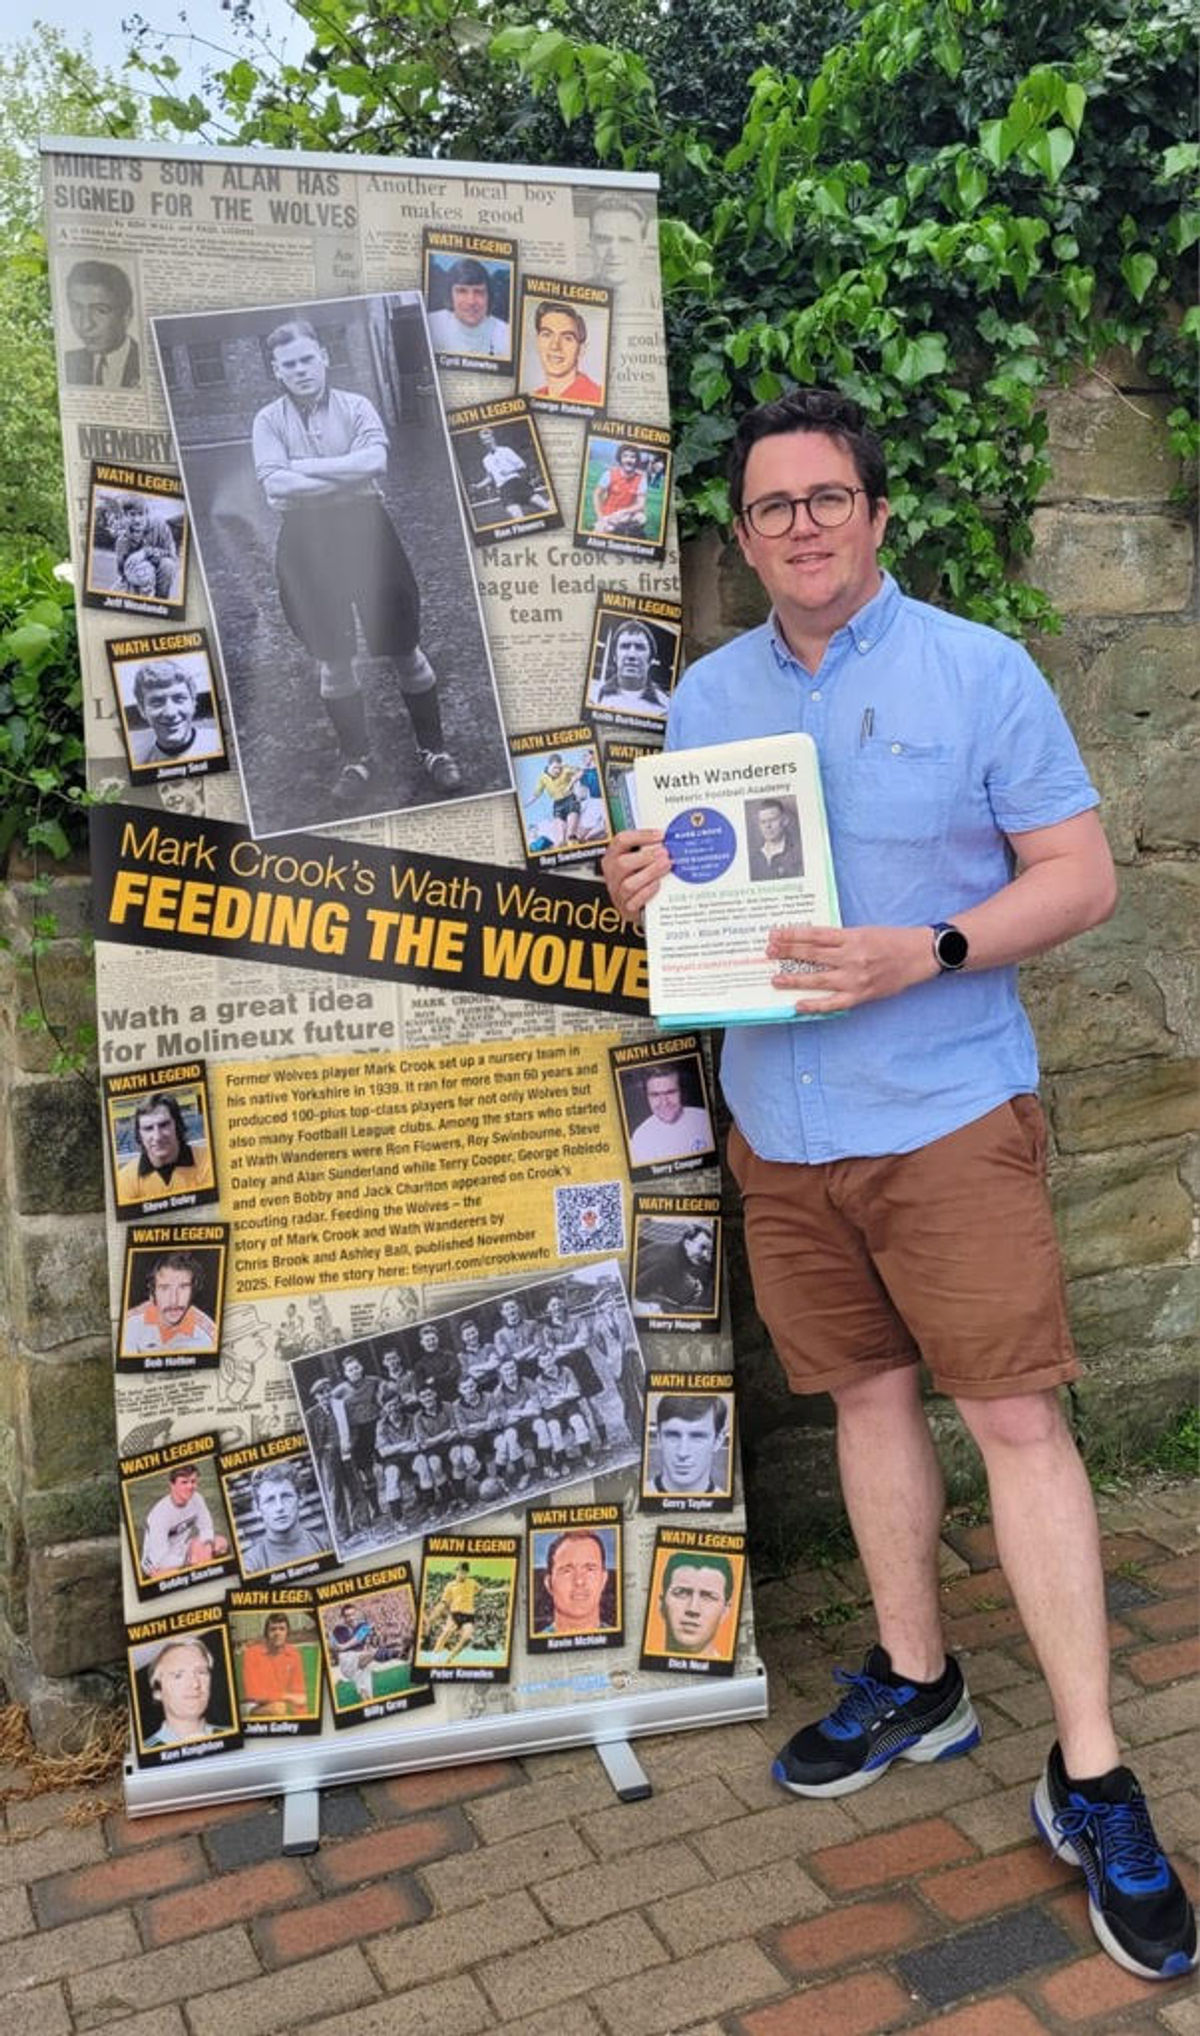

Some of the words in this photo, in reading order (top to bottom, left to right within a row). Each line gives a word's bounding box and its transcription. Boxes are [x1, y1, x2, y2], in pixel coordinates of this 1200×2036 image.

[54, 157, 143, 182] MINER'S
[160, 163, 204, 187] SON
[222, 166, 280, 192] ALAN
[297, 171, 340, 197] HAS
[366, 175, 447, 197] Another
[463, 175, 508, 200] local
[524, 186, 557, 206] boy
[54, 186, 135, 214] SIGNED
[152, 191, 194, 218] FOR
[210, 196, 254, 222] THE
[270, 201, 358, 229] WOLVES
[401, 203, 463, 221] makes
[478, 206, 524, 225] good
[428, 232, 463, 247] WATH
[466, 237, 512, 254] LEGEND
[526, 279, 561, 295] WATH
[563, 285, 608, 302] LEGEND
[620, 352, 667, 365] young
[611, 367, 656, 382] olves
[78, 425, 175, 463] MEMORY
[482, 548, 538, 567] Mark
[547, 548, 629, 566] Crooks
[477, 579, 539, 600] eague
[551, 575, 627, 594] leaders
[639, 573, 680, 591] first
[510, 606, 562, 623] team
[603, 592, 635, 608] WATH
[638, 599, 682, 619] LEGEND
[112, 641, 150, 656] WATH
[152, 633, 202, 650] LEGEND
[510, 734, 544, 752] WATH
[545, 728, 592, 748] LEGEND
[653, 772, 700, 790] Wath
[704, 762, 798, 784] Wanderers
[705, 788, 745, 798] Football
[748, 783, 791, 794] Academy
[120, 822, 218, 873] Mark
[230, 841, 376, 895] Crook's
[390, 865, 482, 912] Wath
[108, 870, 350, 956] FEEDING
[366, 908, 468, 973] THE
[482, 926, 650, 1000] WOLVE
[102, 1005, 179, 1031] Wath
[190, 1004, 206, 1021] a
[217, 993, 297, 1024] great
[308, 990, 373, 1012] idea
[102, 1041, 146, 1063] for
[156, 1028, 294, 1058] Molineux
[304, 1020, 394, 1043] future
[109, 1076, 147, 1092] WATH
[150, 1065, 200, 1084] LEGEND
[226, 1073, 271, 1088] Former
[274, 1069, 318, 1083] Wolves
[322, 1065, 361, 1082] player
[364, 1062, 396, 1076] Mark
[400, 1058, 437, 1074] Crook
[439, 1056, 458, 1070] set
[459, 1055, 475, 1070] up
[477, 1057, 485, 1066] a
[488, 1049, 533, 1063] nursery
[536, 1049, 566, 1060] team
[569, 1044, 580, 1057] in
[227, 1094, 246, 1108] his
[249, 1091, 288, 1105] native
[291, 1086, 350, 1101] Yorkshire
[354, 1084, 366, 1096] in
[370, 1082, 401, 1095] 1939.
[405, 1080, 415, 1092] It
[418, 1081, 438, 1091] ran
[441, 1076, 458, 1089] for
[461, 1073, 492, 1087] more
[493, 1070, 521, 1083] than
[523, 1068, 538, 1080] 60
[541, 1065, 574, 1080] years
[575, 1062, 598, 1075] and
[228, 1111, 288, 1130] produced
[291, 1106, 347, 1123] 100-plus
[350, 1102, 408, 1118] top-class
[411, 1096, 455, 1114] players
[458, 1093, 474, 1107] for
[477, 1090, 497, 1104] not
[500, 1089, 524, 1104] only
[527, 1084, 569, 1100] Wolves
[571, 1083, 591, 1096] but
[229, 1136, 256, 1149] also
[259, 1131, 294, 1146] many
[298, 1126, 347, 1142] Football
[351, 1123, 397, 1139] League
[399, 1118, 435, 1133] clubs.
[438, 1115, 479, 1130] Among
[482, 1113, 501, 1125] the
[504, 1108, 535, 1123] stars
[537, 1106, 563, 1119] who
[565, 1100, 607, 1116] started
[230, 1156, 242, 1169] at
[246, 1151, 278, 1167] Wath
[281, 1146, 349, 1164] Wanderers
[352, 1145, 383, 1157] were
[386, 1141, 411, 1154] Ron
[413, 1135, 465, 1153] Flowers,
[467, 1133, 489, 1147] Roy
[568, 1122, 600, 1135] Steve
[231, 1174, 266, 1191] Daley
[270, 1171, 294, 1185] and
[296, 1169, 325, 1182] Alan
[328, 1163, 399, 1181] Sunderland
[402, 1159, 437, 1174] while
[439, 1156, 469, 1170] Terry
[471, 1151, 515, 1167] Cooper,
[517, 1146, 560, 1162] George
[562, 1140, 610, 1156] Robledo
[232, 1197, 256, 1210] and
[259, 1194, 290, 1206] even
[293, 1189, 333, 1205] Bobby
[336, 1185, 360, 1199] and
[363, 1183, 393, 1197] Jack
[396, 1178, 448, 1194] Charlton
[452, 1171, 507, 1190] appeared
[509, 1171, 525, 1182] on
[527, 1165, 571, 1180] Crook's
[638, 1198, 673, 1211] WATH
[675, 1199, 720, 1211] LEGEND
[133, 1228, 170, 1242] WATH
[173, 1227, 224, 1241] LEGEND
[651, 1374, 685, 1387] WATH
[688, 1375, 733, 1387] LEGEND
[531, 1511, 567, 1524] WATH
[570, 1507, 618, 1522] LEGEND
[429, 1538, 465, 1551] WATH
[467, 1539, 516, 1552] LEGEND
[661, 1530, 696, 1545] WATH
[698, 1534, 745, 1549] LEGEND
[316, 1581, 354, 1599] WATH
[357, 1566, 407, 1589] LEGEND
[127, 1621, 166, 1641] WATH
[170, 1606, 222, 1629] LEGEND
